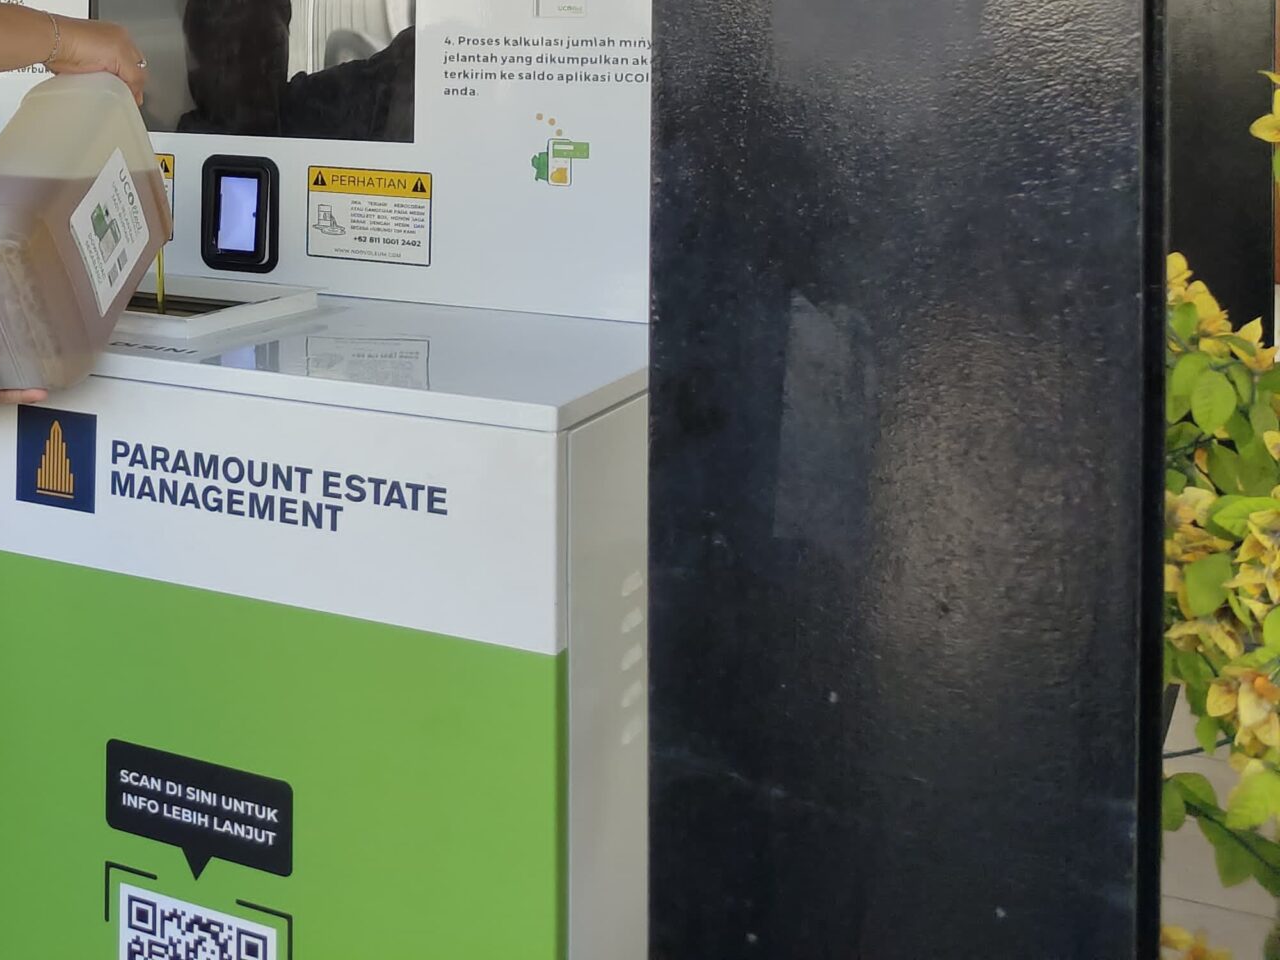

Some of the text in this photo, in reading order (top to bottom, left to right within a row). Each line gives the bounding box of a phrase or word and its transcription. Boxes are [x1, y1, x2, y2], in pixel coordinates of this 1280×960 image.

[444, 36, 455, 46] 4.
[458, 36, 501, 46] Proses
[503, 36, 563, 47] kalkulasi
[565, 36, 615, 49] jumlah
[443, 51, 652, 66] jelantah yang dikumpulkan ak
[444, 68, 497, 80] terkirim
[500, 69, 515, 80] ke
[518, 70, 554, 81] saldo
[557, 71, 611, 83] aplikasi
[444, 86, 479, 96] anda.
[331, 174, 407, 190] PERHATIAN
[383, 237, 399, 246] 1001
[401, 239, 421, 247] 2402
[111, 440, 448, 515] PARAMOUNT ESTATE
[111, 470, 343, 532] MANAGEMENT
[120, 769, 279, 823] SCAN DI SINI UNTUK
[122, 792, 277, 846] INFO LEBIH LANJUT
